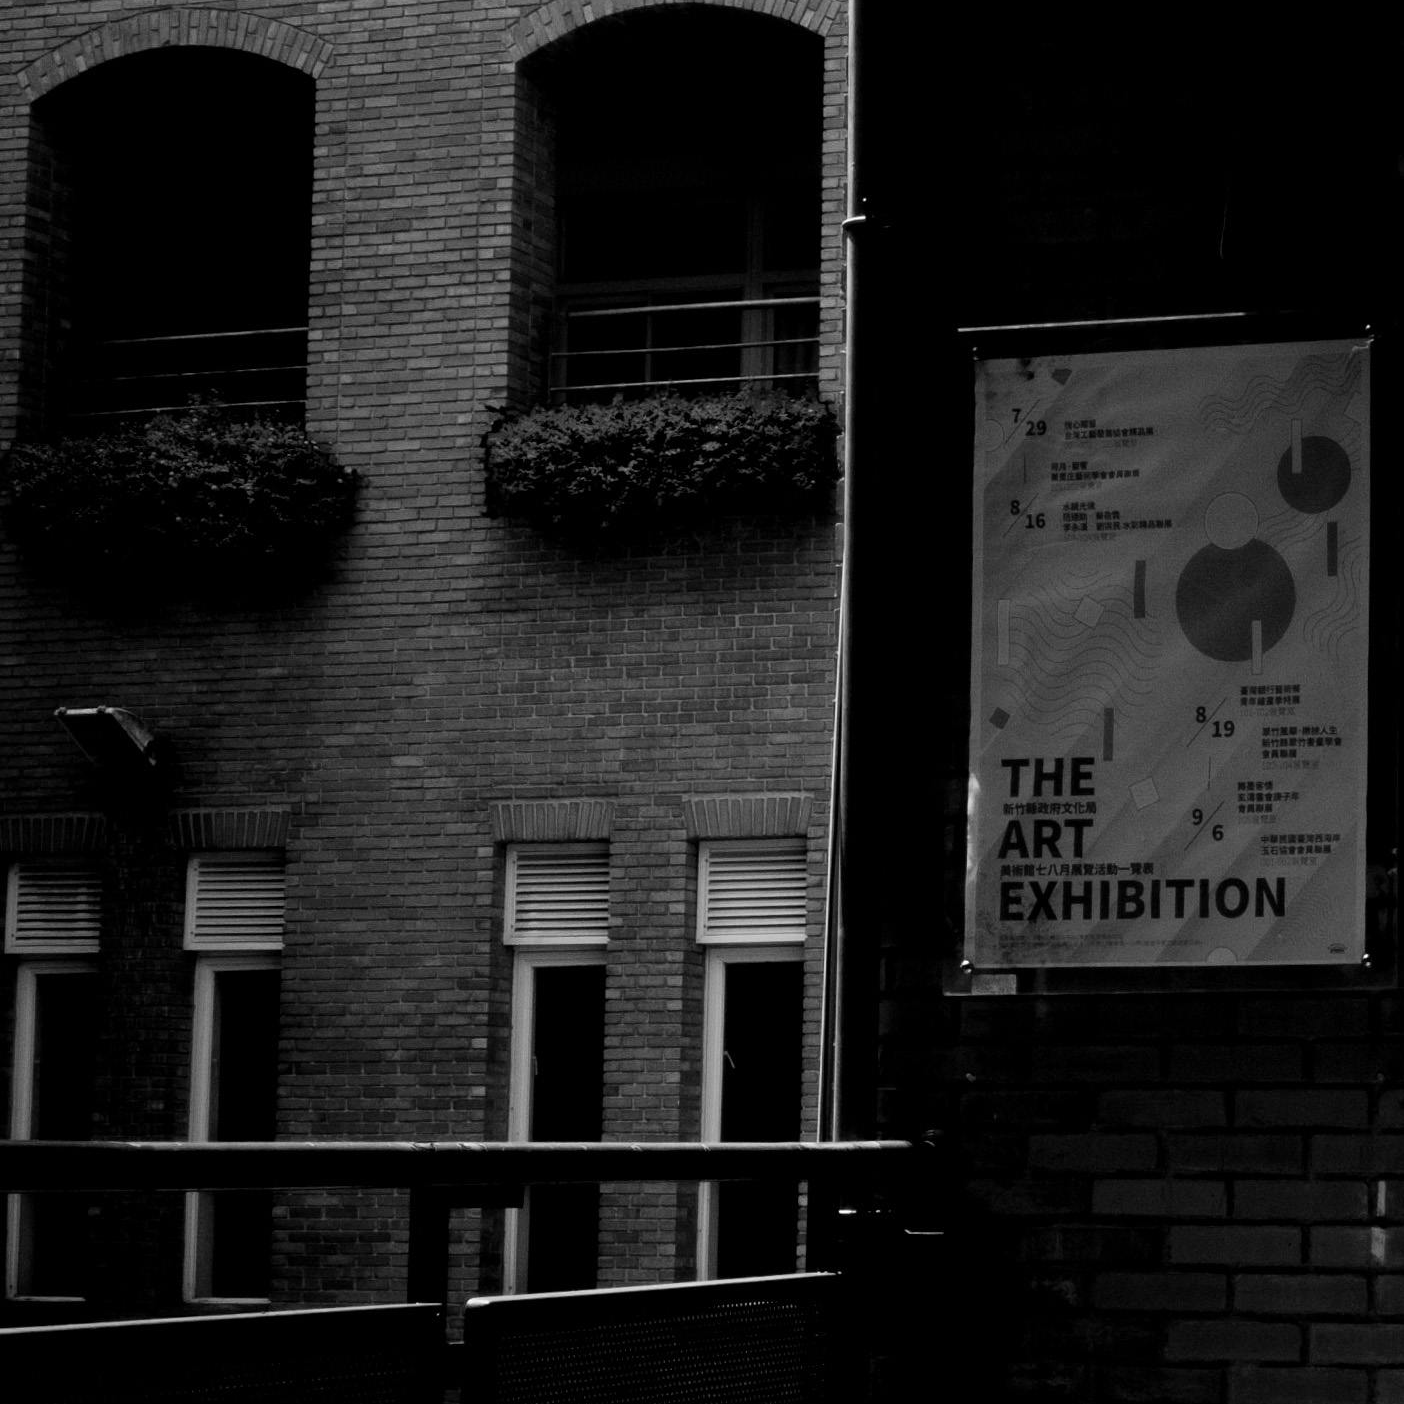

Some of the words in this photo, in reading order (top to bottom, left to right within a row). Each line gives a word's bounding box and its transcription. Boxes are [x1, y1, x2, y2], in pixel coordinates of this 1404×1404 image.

[1011, 408, 1022, 424] 7
[1025, 420, 1047, 437] 29
[1010, 499, 1021, 516] 8
[1025, 513, 1046, 529] 16
[1195, 706, 1207, 723] 8
[1212, 720, 1235, 737] 19
[1002, 756, 1096, 798] THE
[1003, 801, 1097, 816] 新竹縣政府文化局
[998, 818, 1094, 859] ART
[1191, 808, 1204, 826] 9
[1212, 824, 1224, 842] 6
[1000, 862, 1155, 877] 美術館七八月展覽活動一覽表
[999, 875, 1286, 923] EXHIBITION
